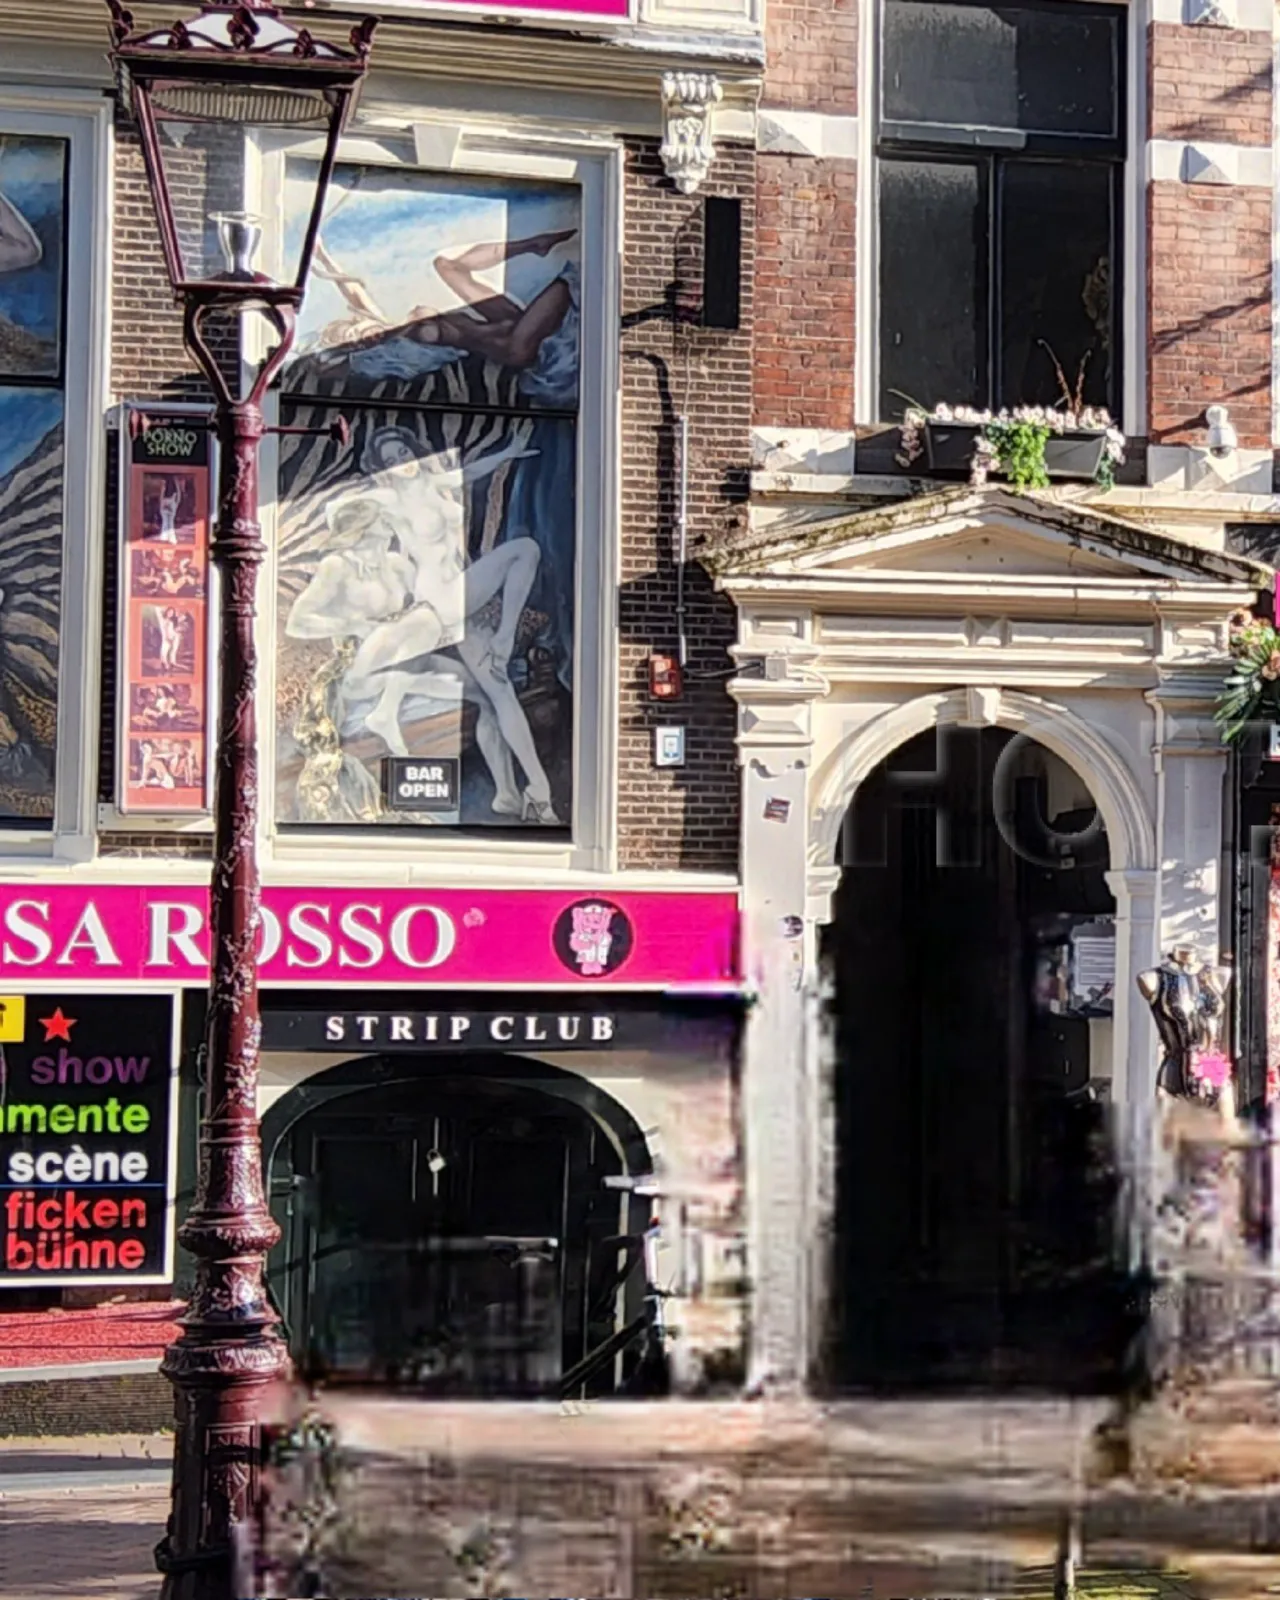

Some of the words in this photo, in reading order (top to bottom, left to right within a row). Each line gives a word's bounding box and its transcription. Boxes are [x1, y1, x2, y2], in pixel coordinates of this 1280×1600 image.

[143, 428, 198, 445] PORNO
[147, 443, 194, 457] SHOW
[398, 783, 449, 798] OPEN
[406, 766, 443, 781] BAR
[3, 899, 123, 966] SA
[326, 1016, 471, 1041] STRIP
[490, 1016, 614, 1041] CLUB
[30, 1047, 151, 1085] show
[0, 1096, 151, 1134] mente
[7, 1143, 149, 1183] scène
[4, 1190, 147, 1230] ficken
[6, 1230, 146, 1271] bühne
